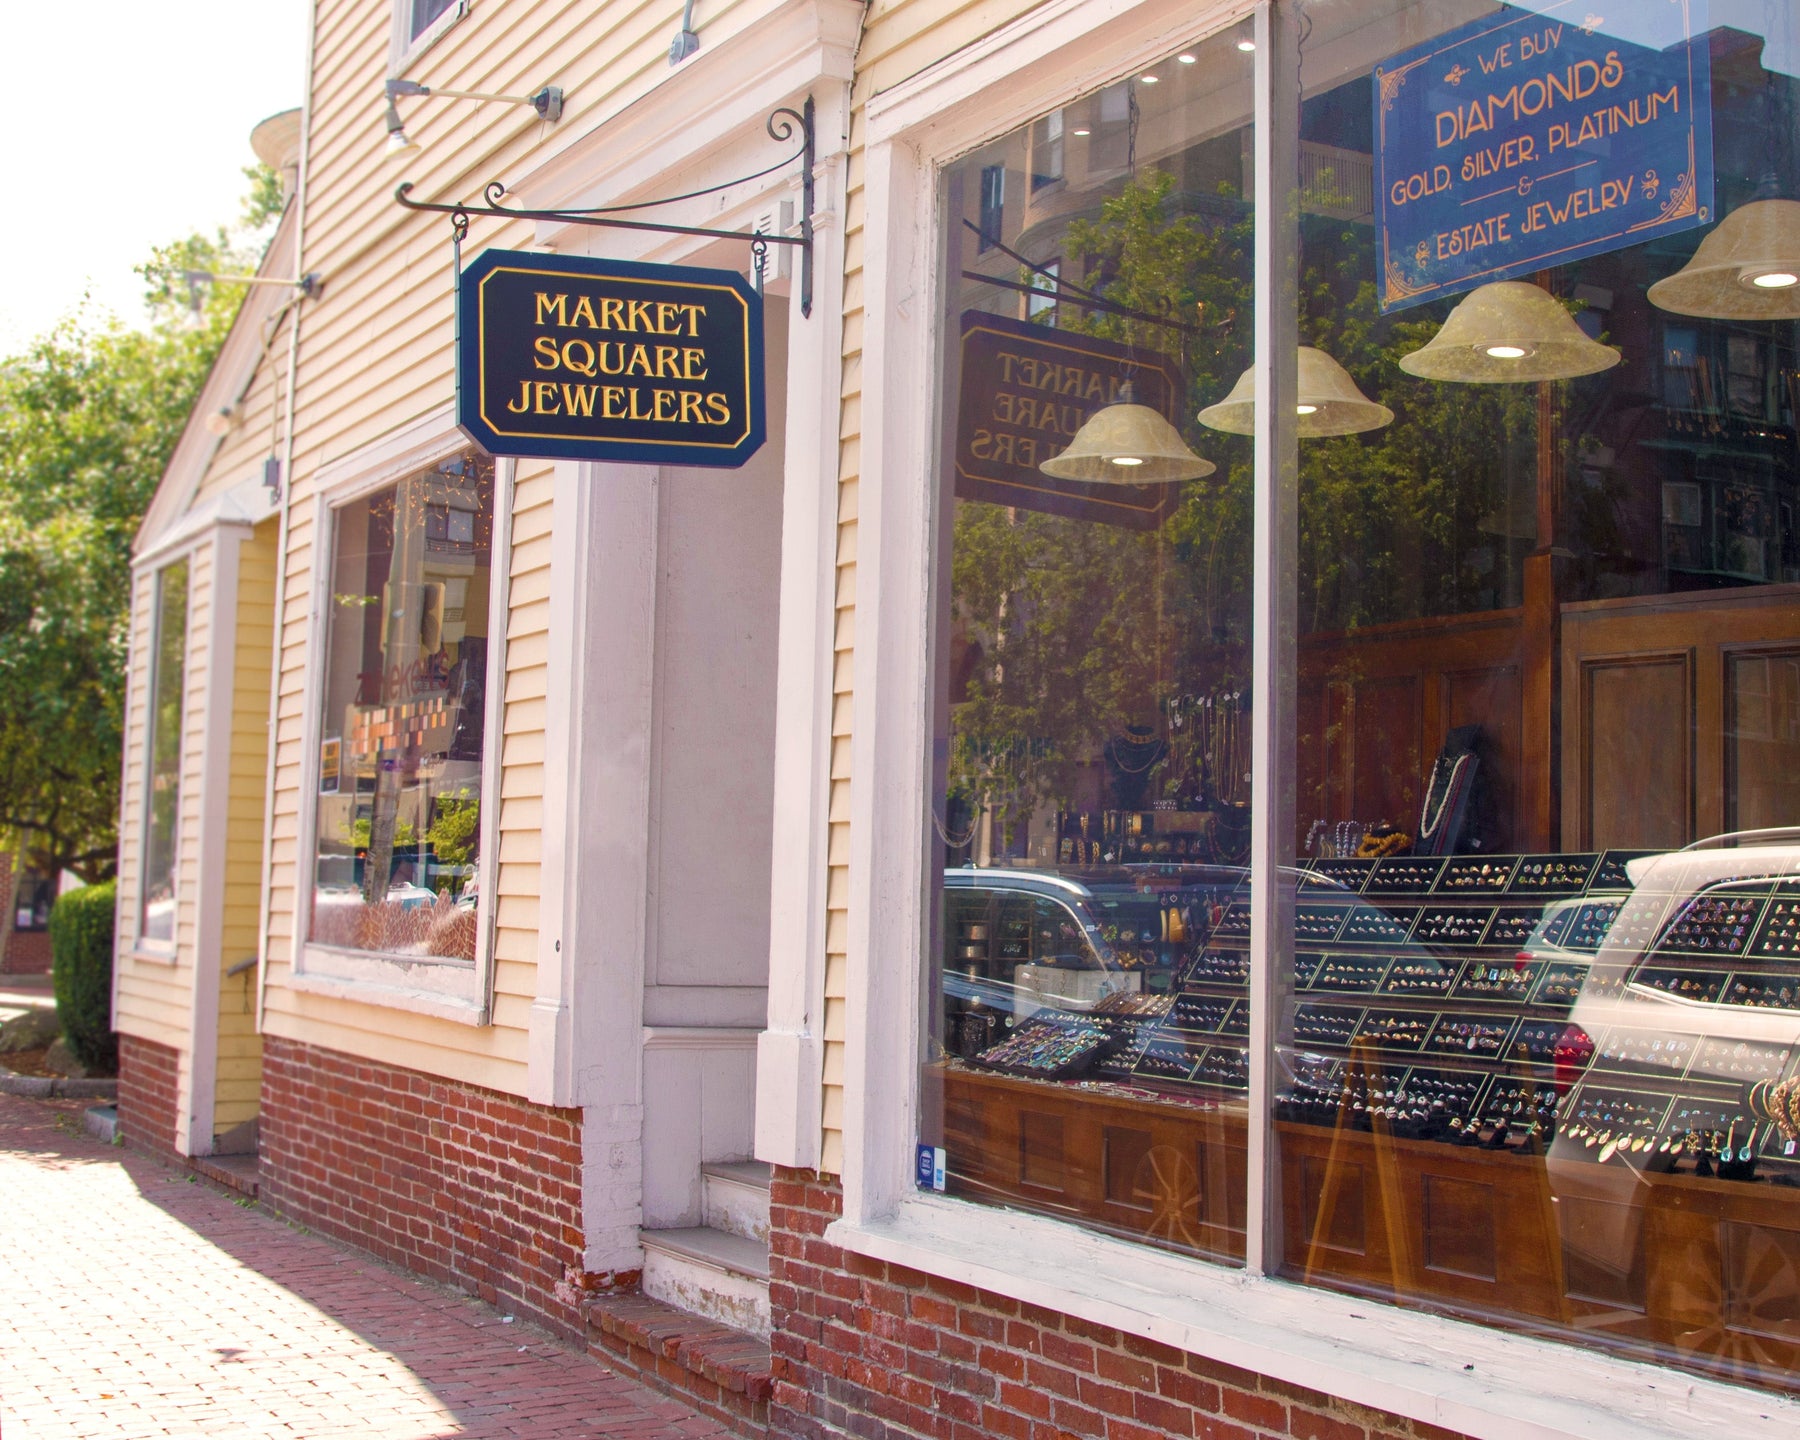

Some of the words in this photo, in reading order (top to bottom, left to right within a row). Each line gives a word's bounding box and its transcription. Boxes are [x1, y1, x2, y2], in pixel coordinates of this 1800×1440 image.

[1478, 43, 1512, 75] WE
[1520, 24, 1563, 60] BUY
[1436, 51, 1624, 148] DIAMONDS
[1391, 165, 1453, 206] GOLD,
[1461, 135, 1539, 181] SILVER,
[1549, 85, 1679, 154] PLATINUM
[1517, 176, 1534, 196] &
[1436, 213, 1511, 261] ESTATE
[1521, 175, 1634, 234] JEWELRY
[534, 292, 706, 337] MARKET
[533, 336, 708, 381] SQUARE
[507, 380, 731, 426] JEWELERS
